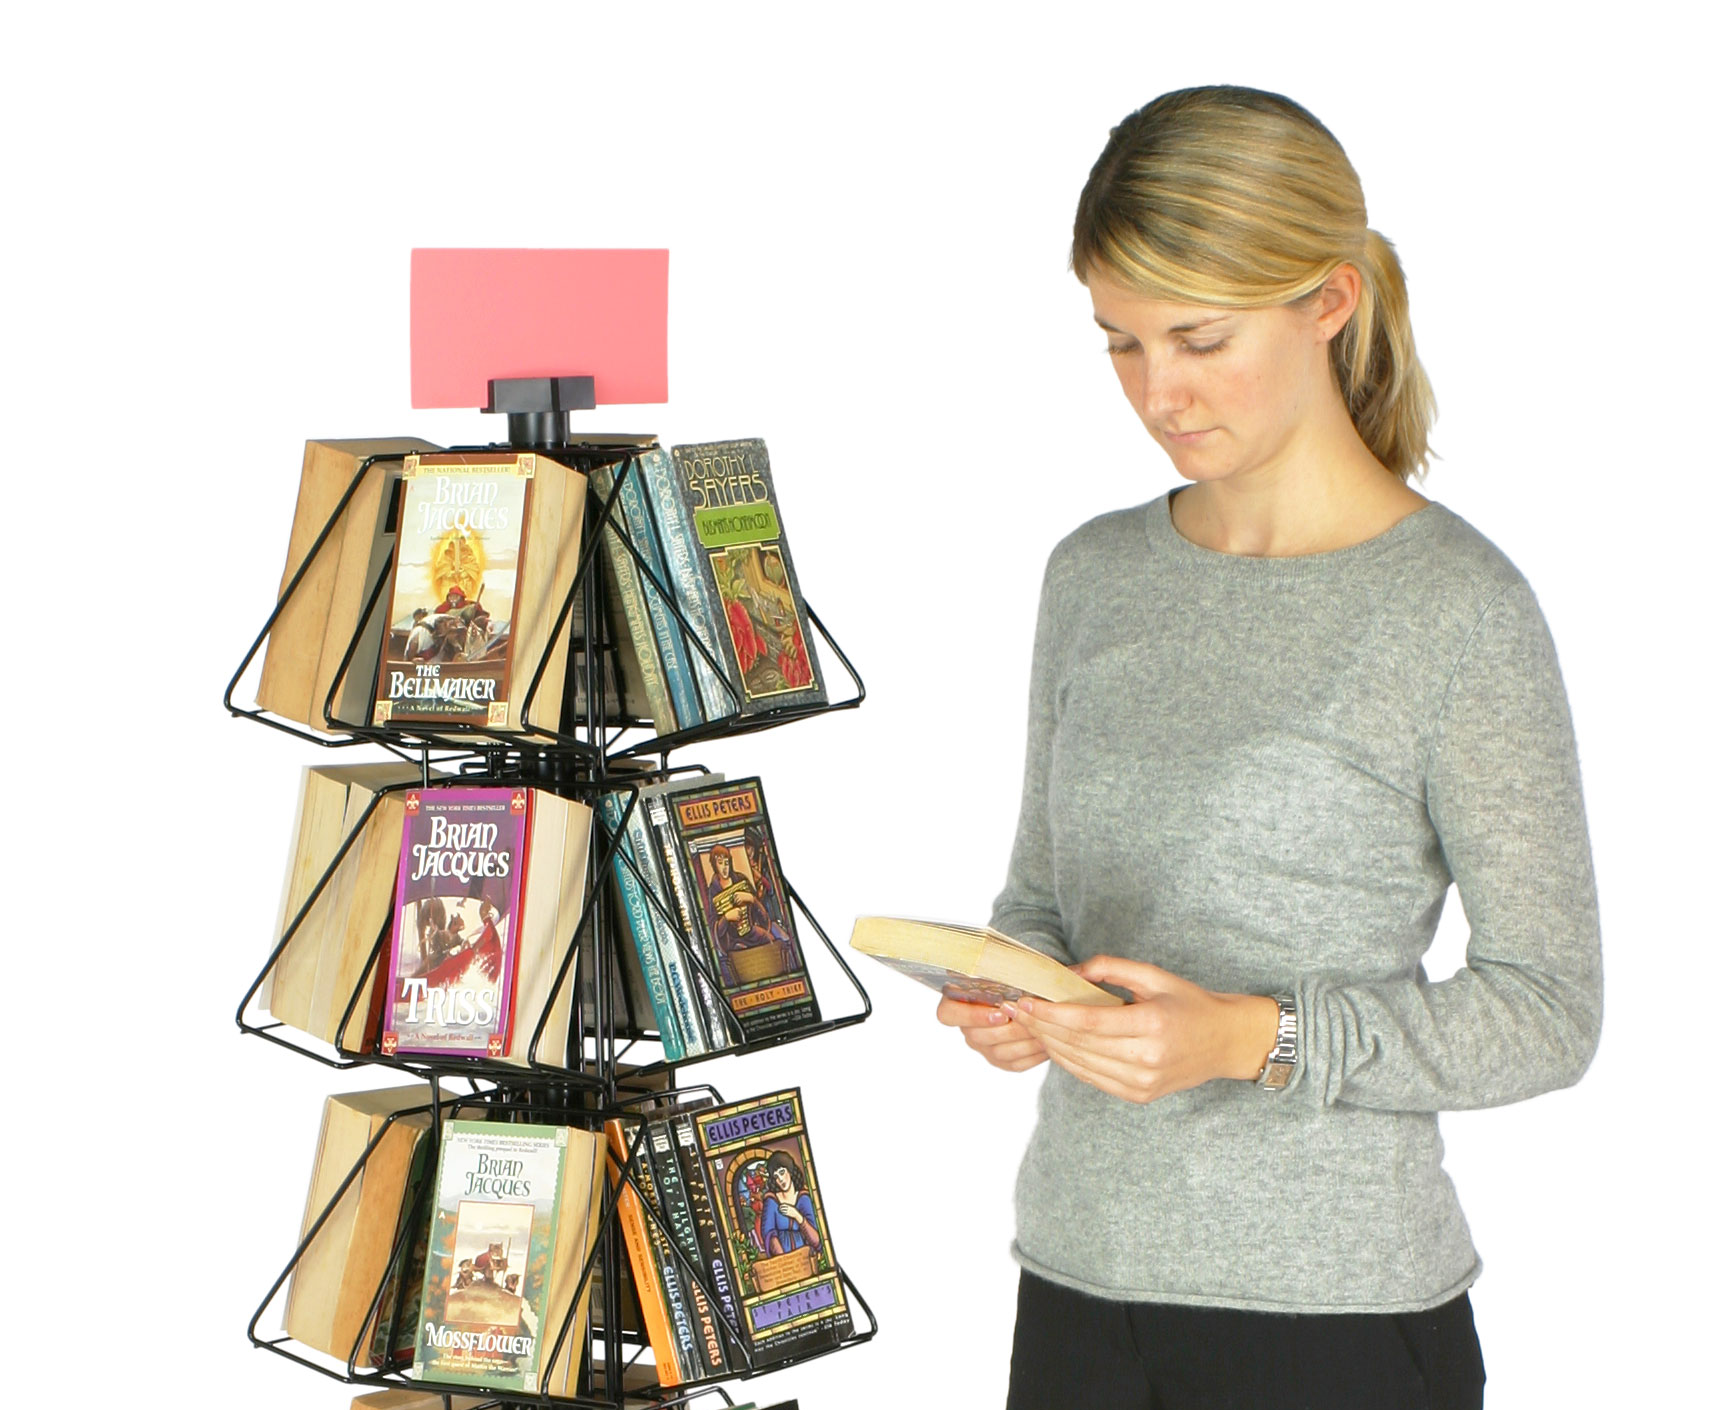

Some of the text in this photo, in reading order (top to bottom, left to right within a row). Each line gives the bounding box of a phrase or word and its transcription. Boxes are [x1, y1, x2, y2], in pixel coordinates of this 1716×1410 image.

[684, 454, 747, 480] DOROTHY
[433, 476, 498, 507] BRIAN
[690, 474, 768, 508] SAYERS
[418, 503, 508, 537] JACQUES
[389, 671, 495, 701] BELLMAKER
[416, 665, 440, 677] THE
[685, 795, 751, 820] ELLIS PETERS
[429, 816, 498, 850] BRIAN
[412, 845, 509, 883] JACQUES
[402, 978, 495, 1027] TRISS
[733, 983, 802, 1007] THE HOLY THIEF
[707, 1120, 740, 1140] ELLIS
[741, 1106, 793, 1131] PETERS
[477, 1153, 523, 1177] BRIAN
[465, 1171, 531, 1199] JACQUES
[662, 1176, 673, 1195] OF
[665, 1157, 699, 1263] THE PILGRIM
[688, 1180, 706, 1226] FAIR
[696, 1181, 721, 1254] PETER'S
[711, 1258, 728, 1293] ELLIS
[662, 1265, 692, 1351] ELLIS PETERS
[775, 1285, 832, 1308] PETER'S
[776, 1302, 812, 1318] FAIR
[425, 1322, 532, 1356] MOSSFLOWER
[690, 1279, 722, 1367] ELLIS PETERS
